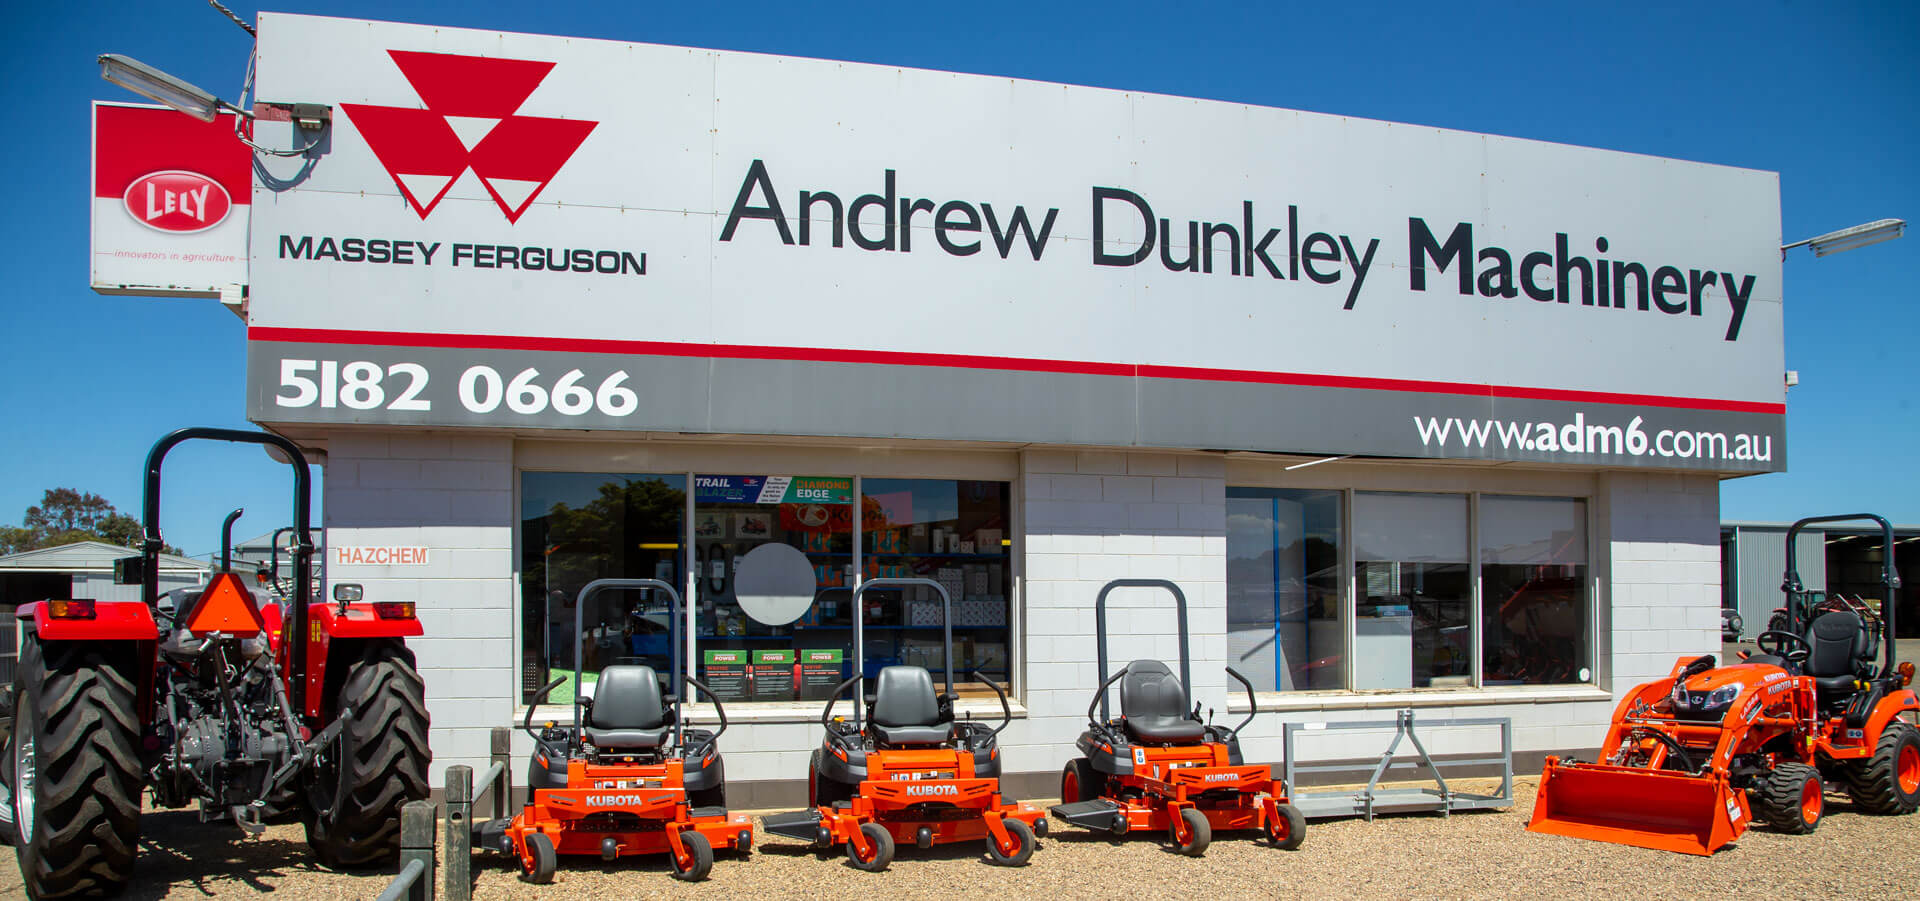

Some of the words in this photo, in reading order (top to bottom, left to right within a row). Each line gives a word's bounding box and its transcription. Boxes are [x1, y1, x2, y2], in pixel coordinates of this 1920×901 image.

[147, 181, 210, 222] LELY
[114, 249, 167, 260] innovators
[170, 250, 179, 260] in
[182, 251, 235, 263] agriculture
[278, 235, 441, 266] MASSEY
[451, 243, 647, 276] FERGUSON
[719, 159, 1060, 262] Andrew
[1092, 185, 1380, 311] Dunkley
[1408, 216, 1757, 342] Machinery
[276, 358, 432, 411] 5182
[458, 365, 639, 417] 0666
[1414, 412, 1772, 462] www.adm6.com.au
[695, 478, 731, 487] TRAIL
[796, 480, 850, 489] DIAMOND
[796, 489, 830, 498] EDGE
[338, 547, 427, 563] HAZCHEM
[1767, 680, 1792, 695] KUBOTA
[1204, 772, 1239, 783] KUBOTA
[906, 785, 959, 796] KUBOTA
[585, 795, 642, 807] KUBOTA
